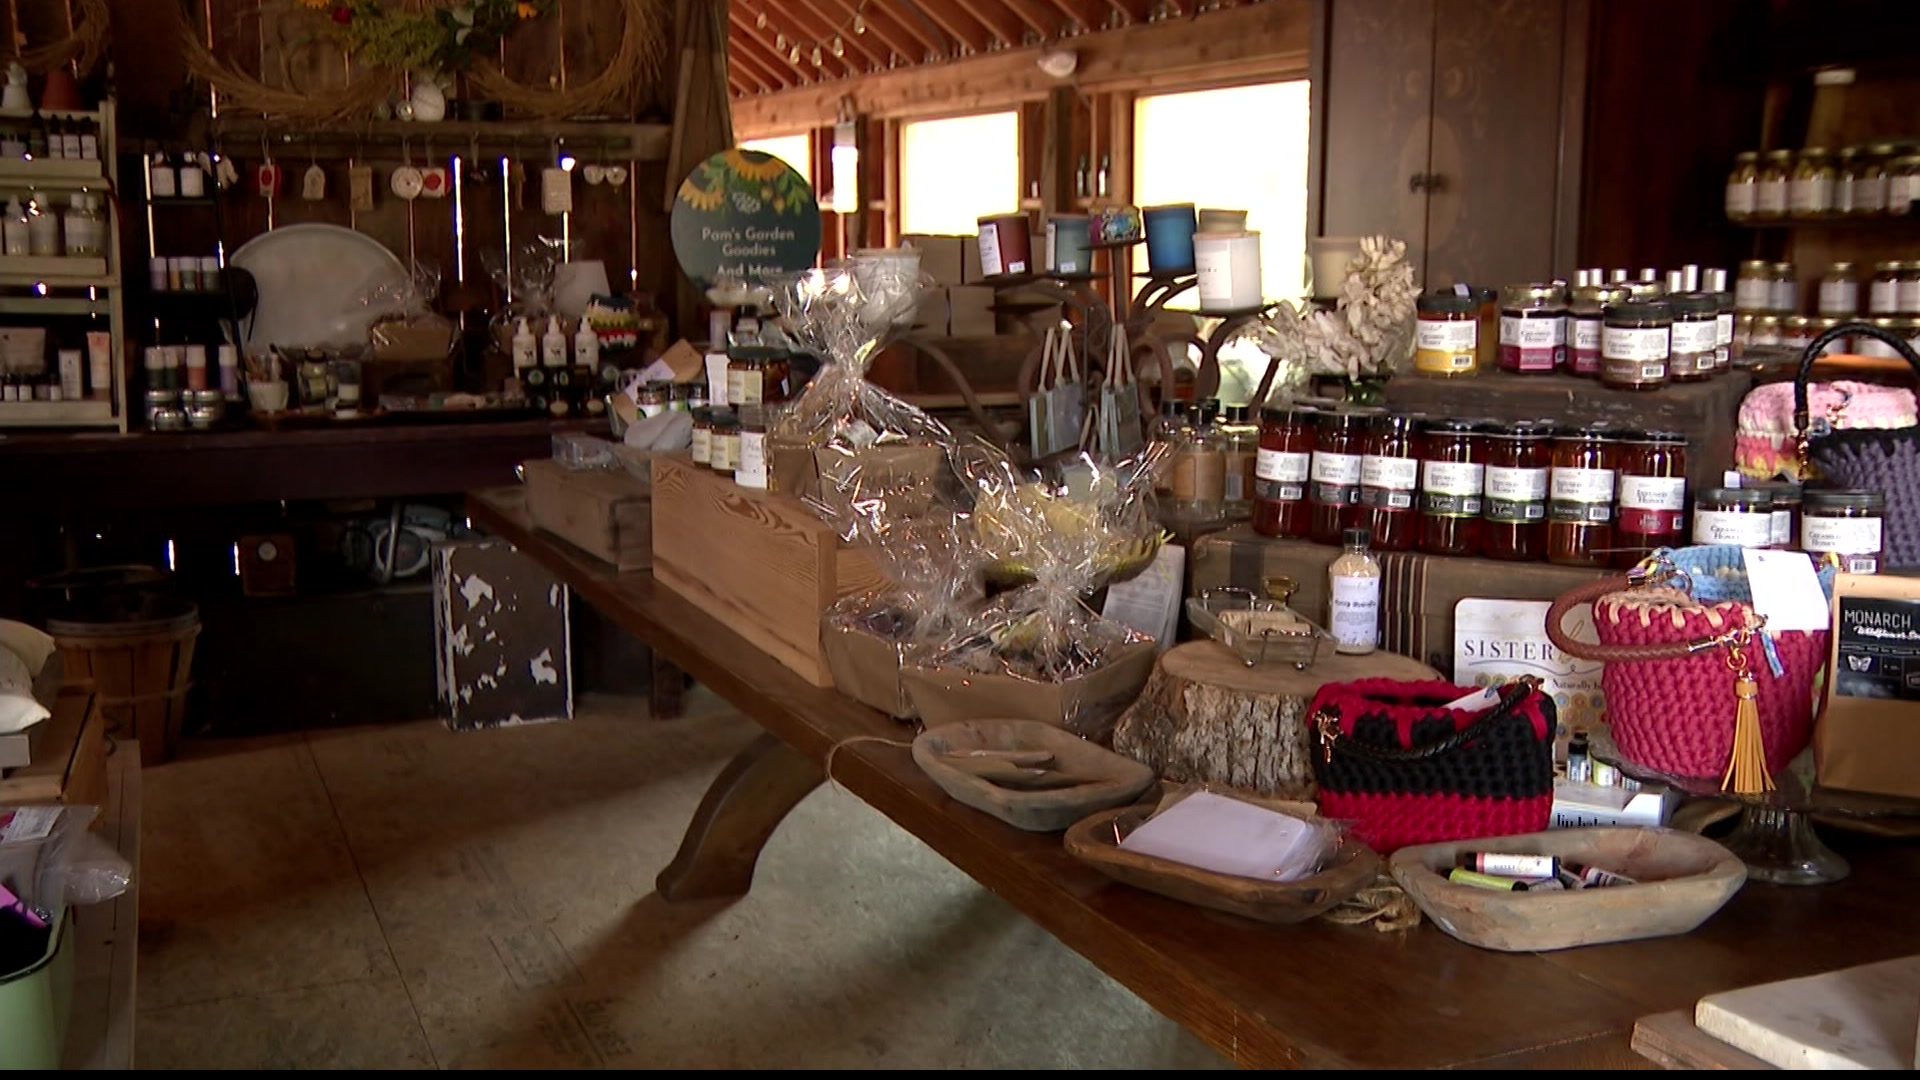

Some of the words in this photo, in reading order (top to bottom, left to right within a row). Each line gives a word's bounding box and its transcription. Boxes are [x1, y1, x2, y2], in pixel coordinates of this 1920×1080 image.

[702, 227, 740, 240] Pam's
[745, 226, 795, 240] Garden
[722, 242, 776, 256] Goodies
[717, 263, 744, 277] And
[1844, 609, 1912, 629] MONARCH
[1464, 639, 1553, 660] SISTER
